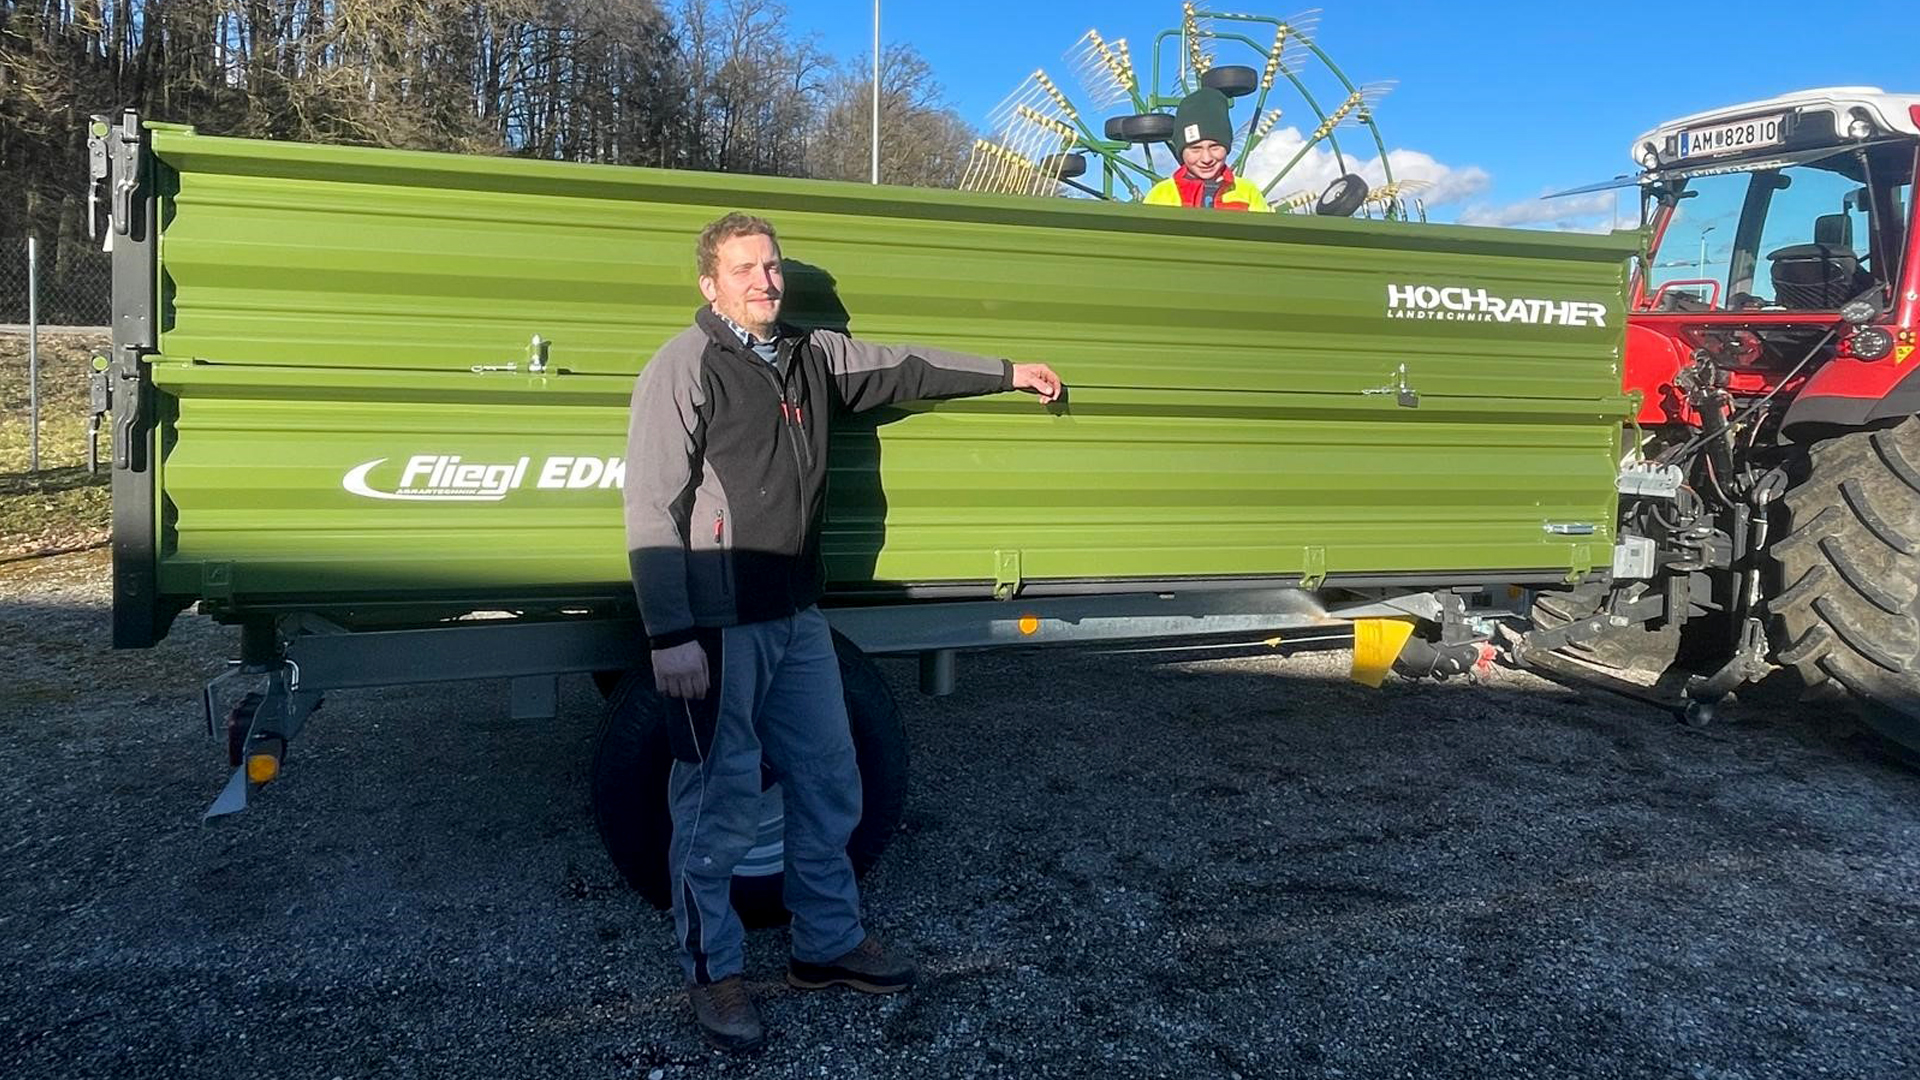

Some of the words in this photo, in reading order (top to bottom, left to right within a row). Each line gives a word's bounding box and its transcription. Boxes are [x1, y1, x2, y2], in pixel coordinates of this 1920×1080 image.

[1691, 132, 1713, 152] AM
[1725, 125, 1755, 147] 828
[1387, 284, 1607, 327] HOCHRATHER
[1387, 310, 1493, 322] LANDTECHNIK
[400, 455, 530, 495] Fliegl
